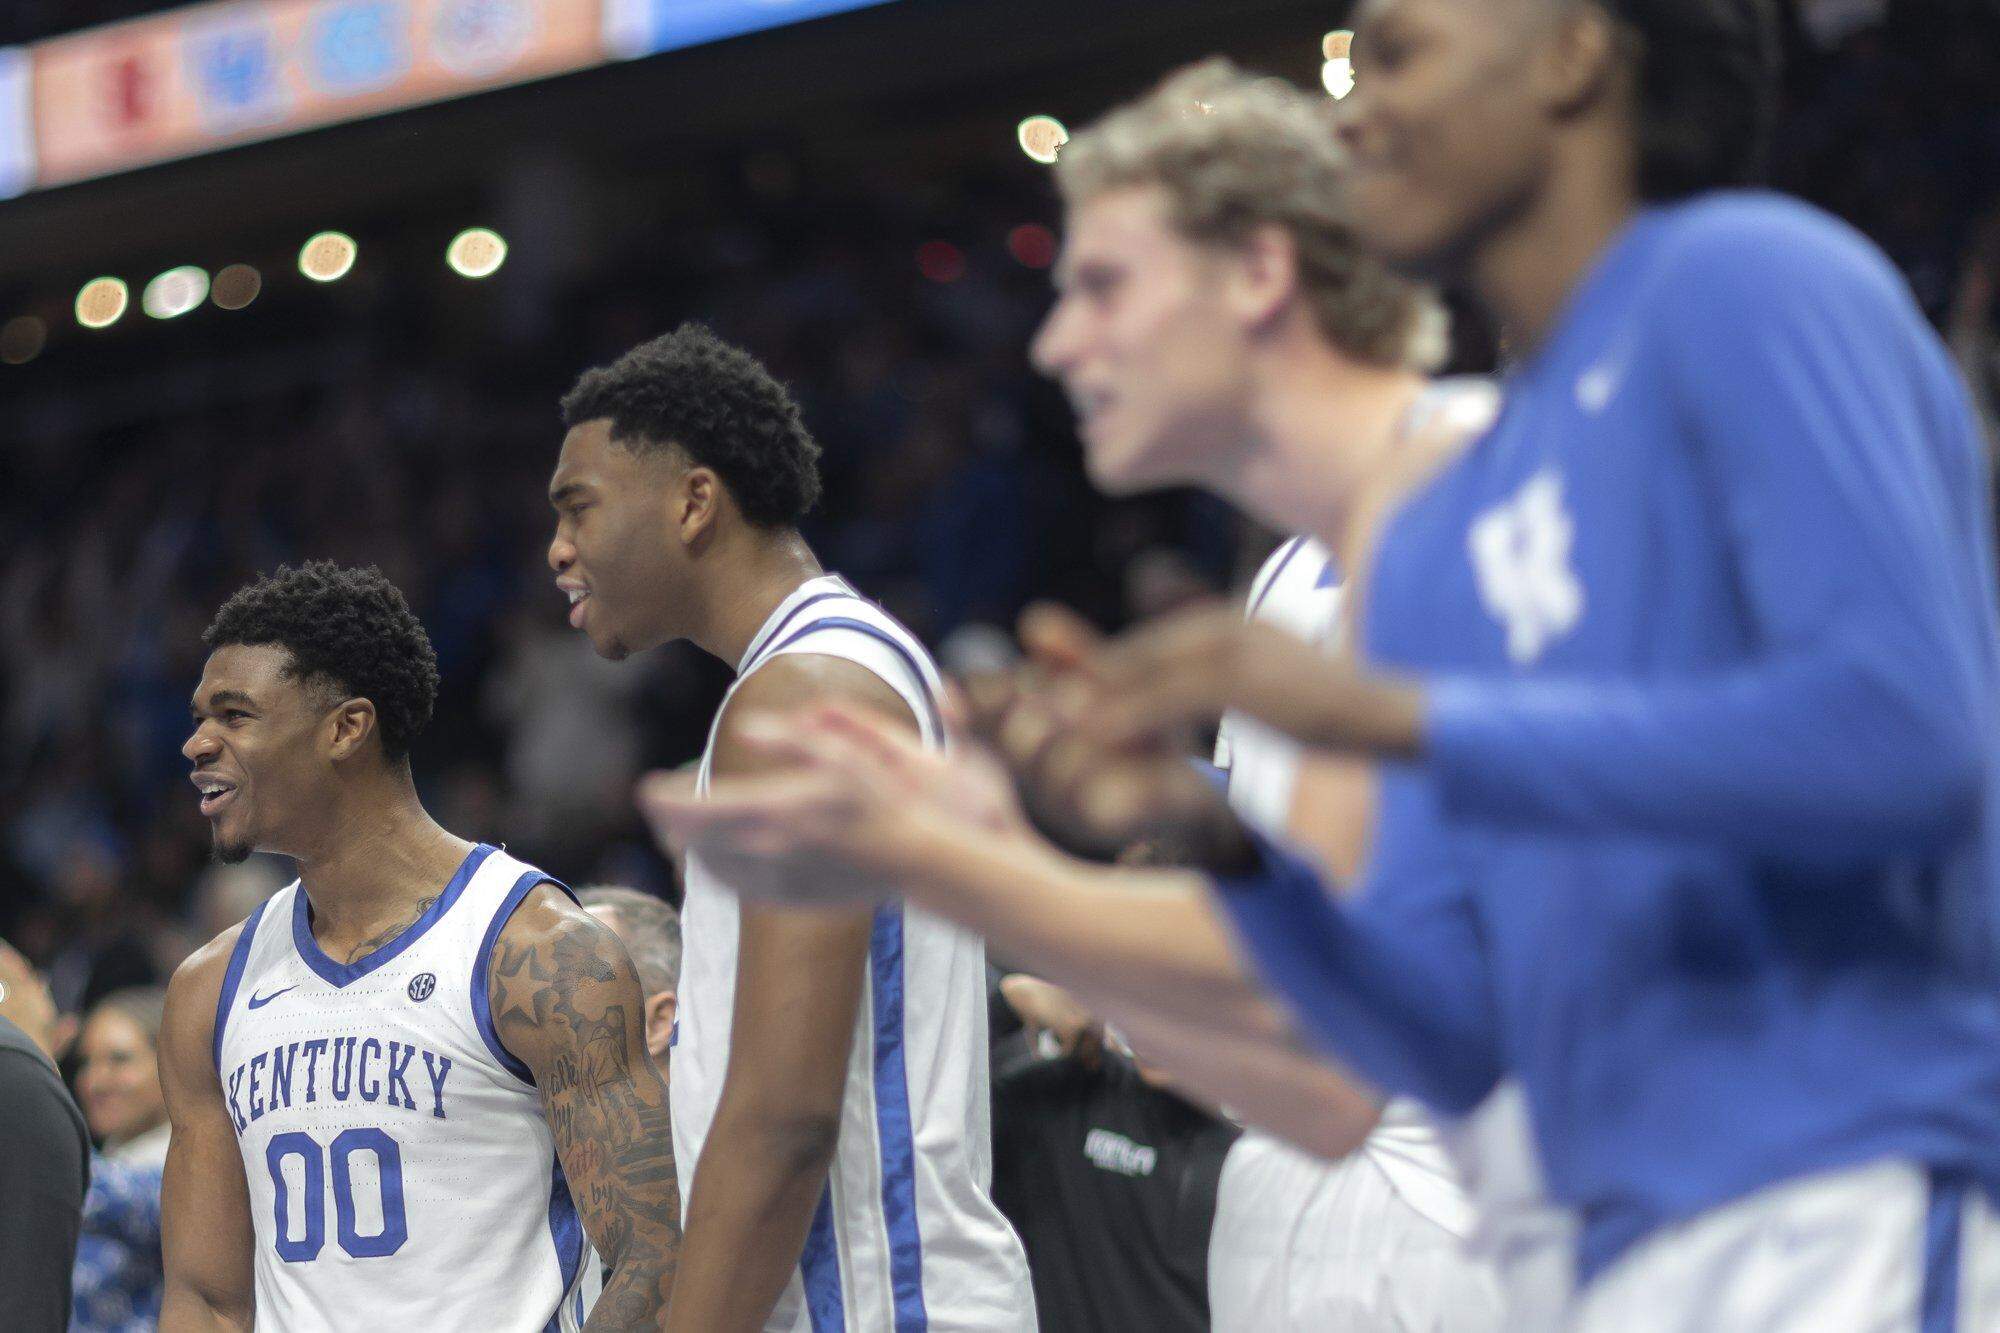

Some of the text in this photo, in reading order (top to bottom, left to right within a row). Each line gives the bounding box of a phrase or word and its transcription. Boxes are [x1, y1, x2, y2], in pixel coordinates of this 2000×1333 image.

[410, 974, 435, 1000] SEC
[229, 1036, 452, 1137] KENTUCKY
[266, 1127, 409, 1263] 00
